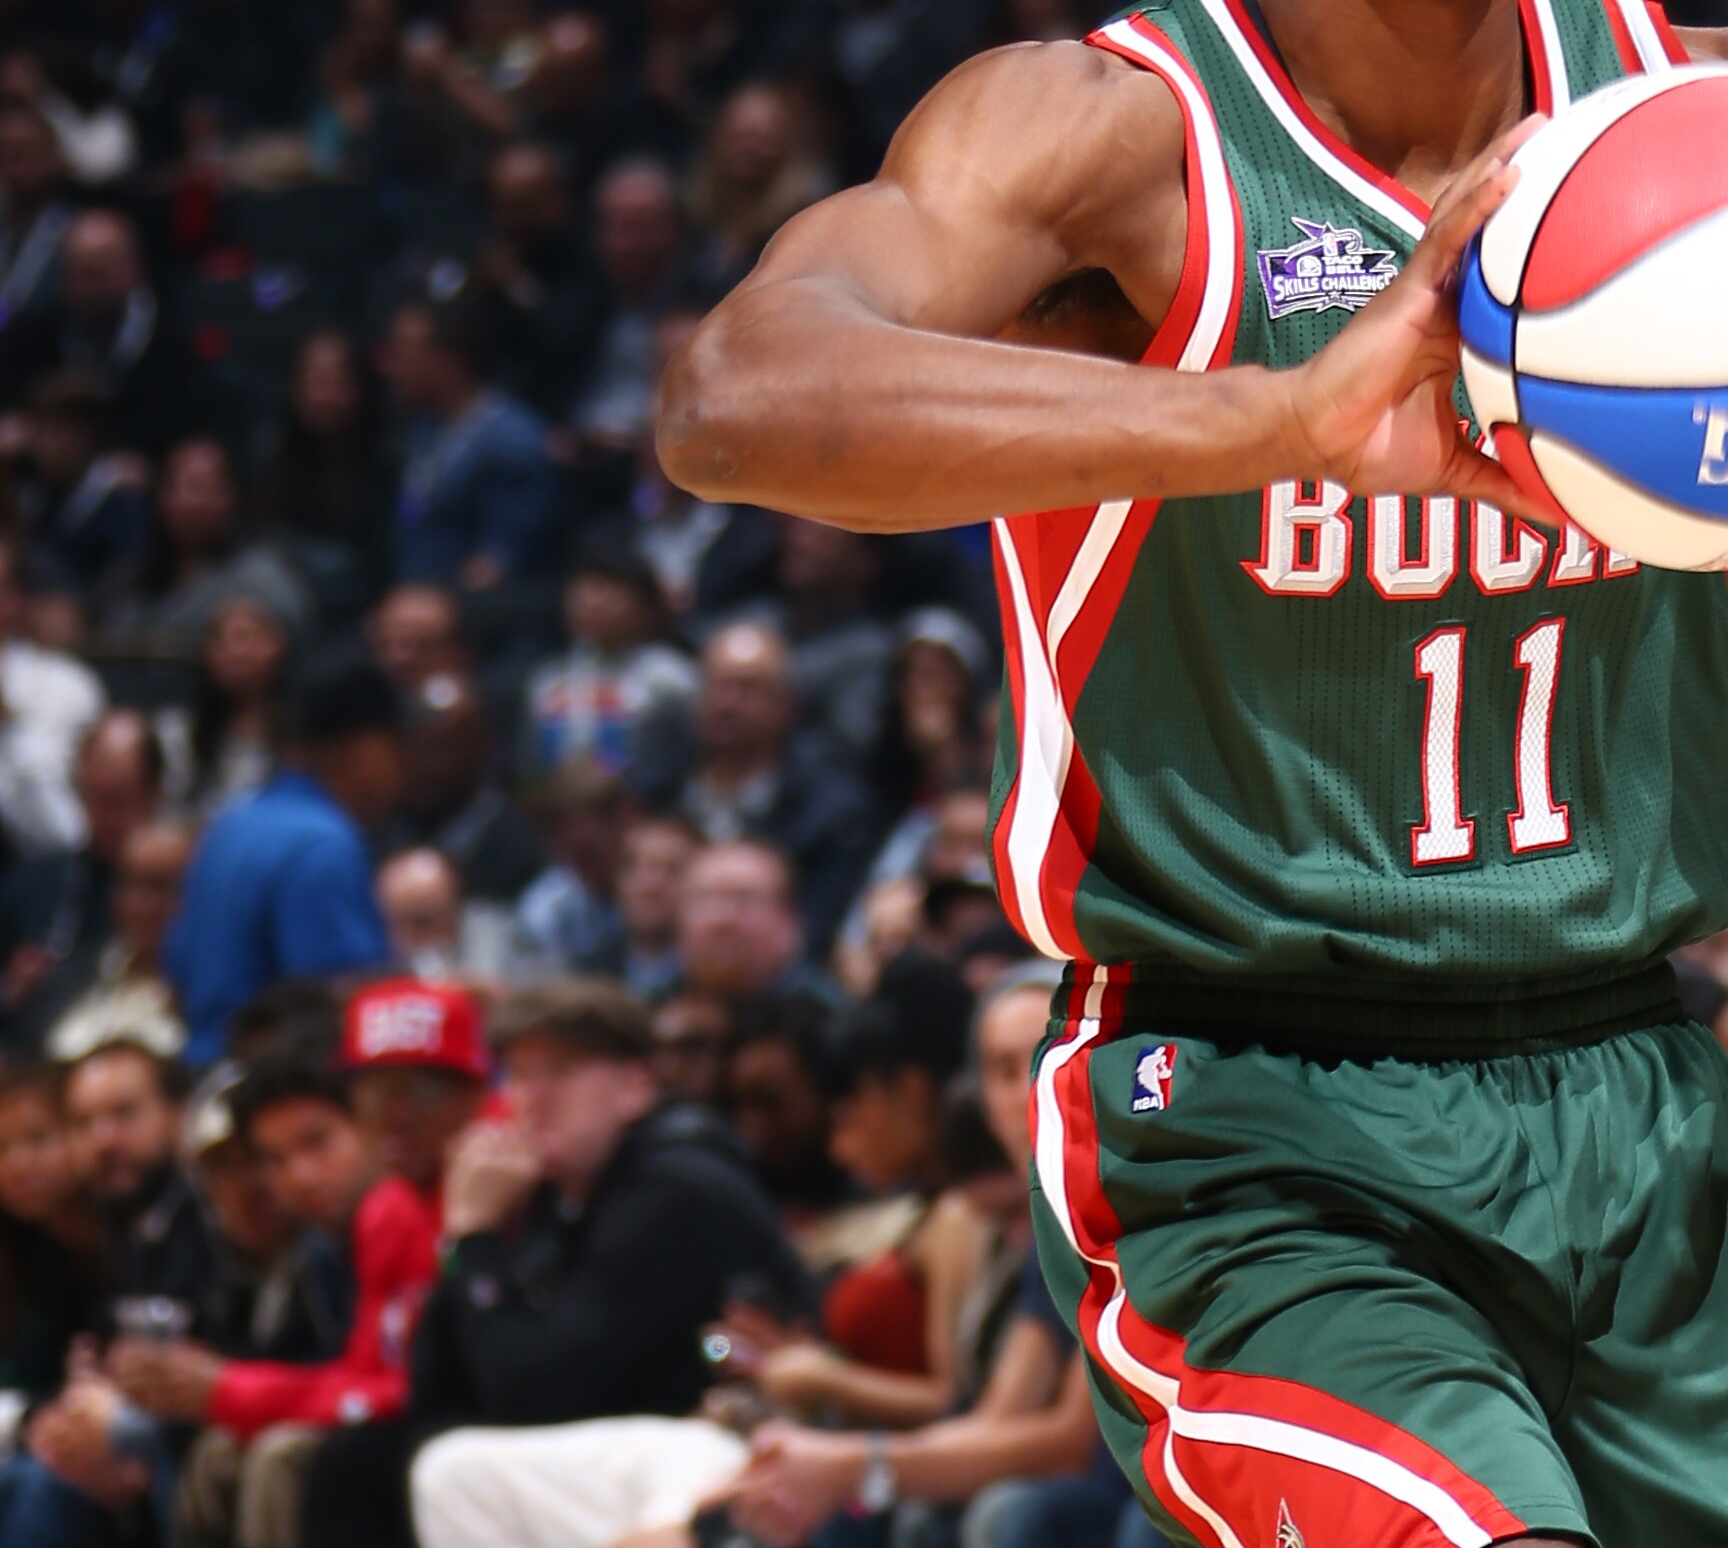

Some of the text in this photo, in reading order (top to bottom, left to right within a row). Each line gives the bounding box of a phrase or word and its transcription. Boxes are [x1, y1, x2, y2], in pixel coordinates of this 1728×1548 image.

[1322, 256, 1364, 265] TACO
[1273, 274, 1319, 302] SKILLS
[1411, 616, 1573, 868] 11
